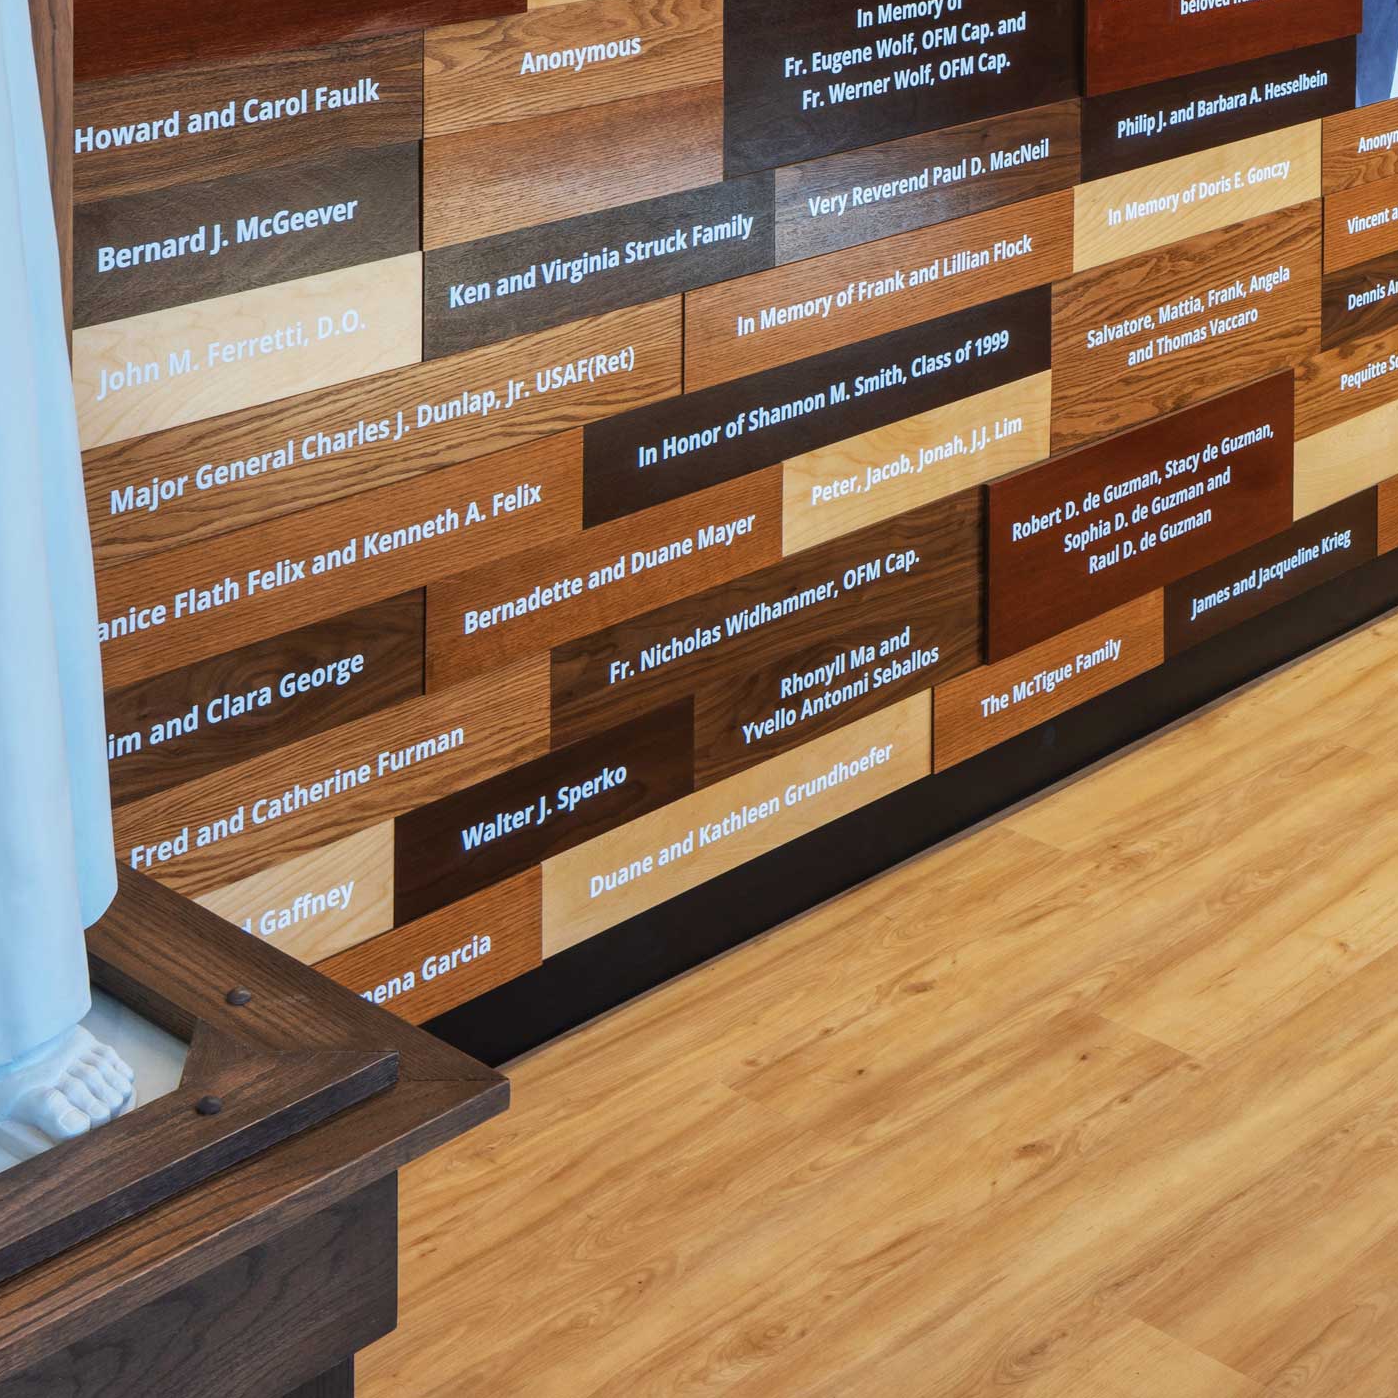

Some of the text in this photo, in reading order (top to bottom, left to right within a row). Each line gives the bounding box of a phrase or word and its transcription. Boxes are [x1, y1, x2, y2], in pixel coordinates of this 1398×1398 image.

[520, 37, 641, 75] Anonymous
[75, 77, 379, 154] Howard and Carol Faulk
[98, 200, 358, 273] Bernard J. McGeever
[110, 345, 635, 514] Major General Charles J. Dunlap, Jr. USAF(Ret)
[1190, 529, 1351, 621] James and Jacqueline Krieg
[980, 638, 1121, 718] The McTigue Family
[462, 766, 626, 850] Walter J. Sperko
